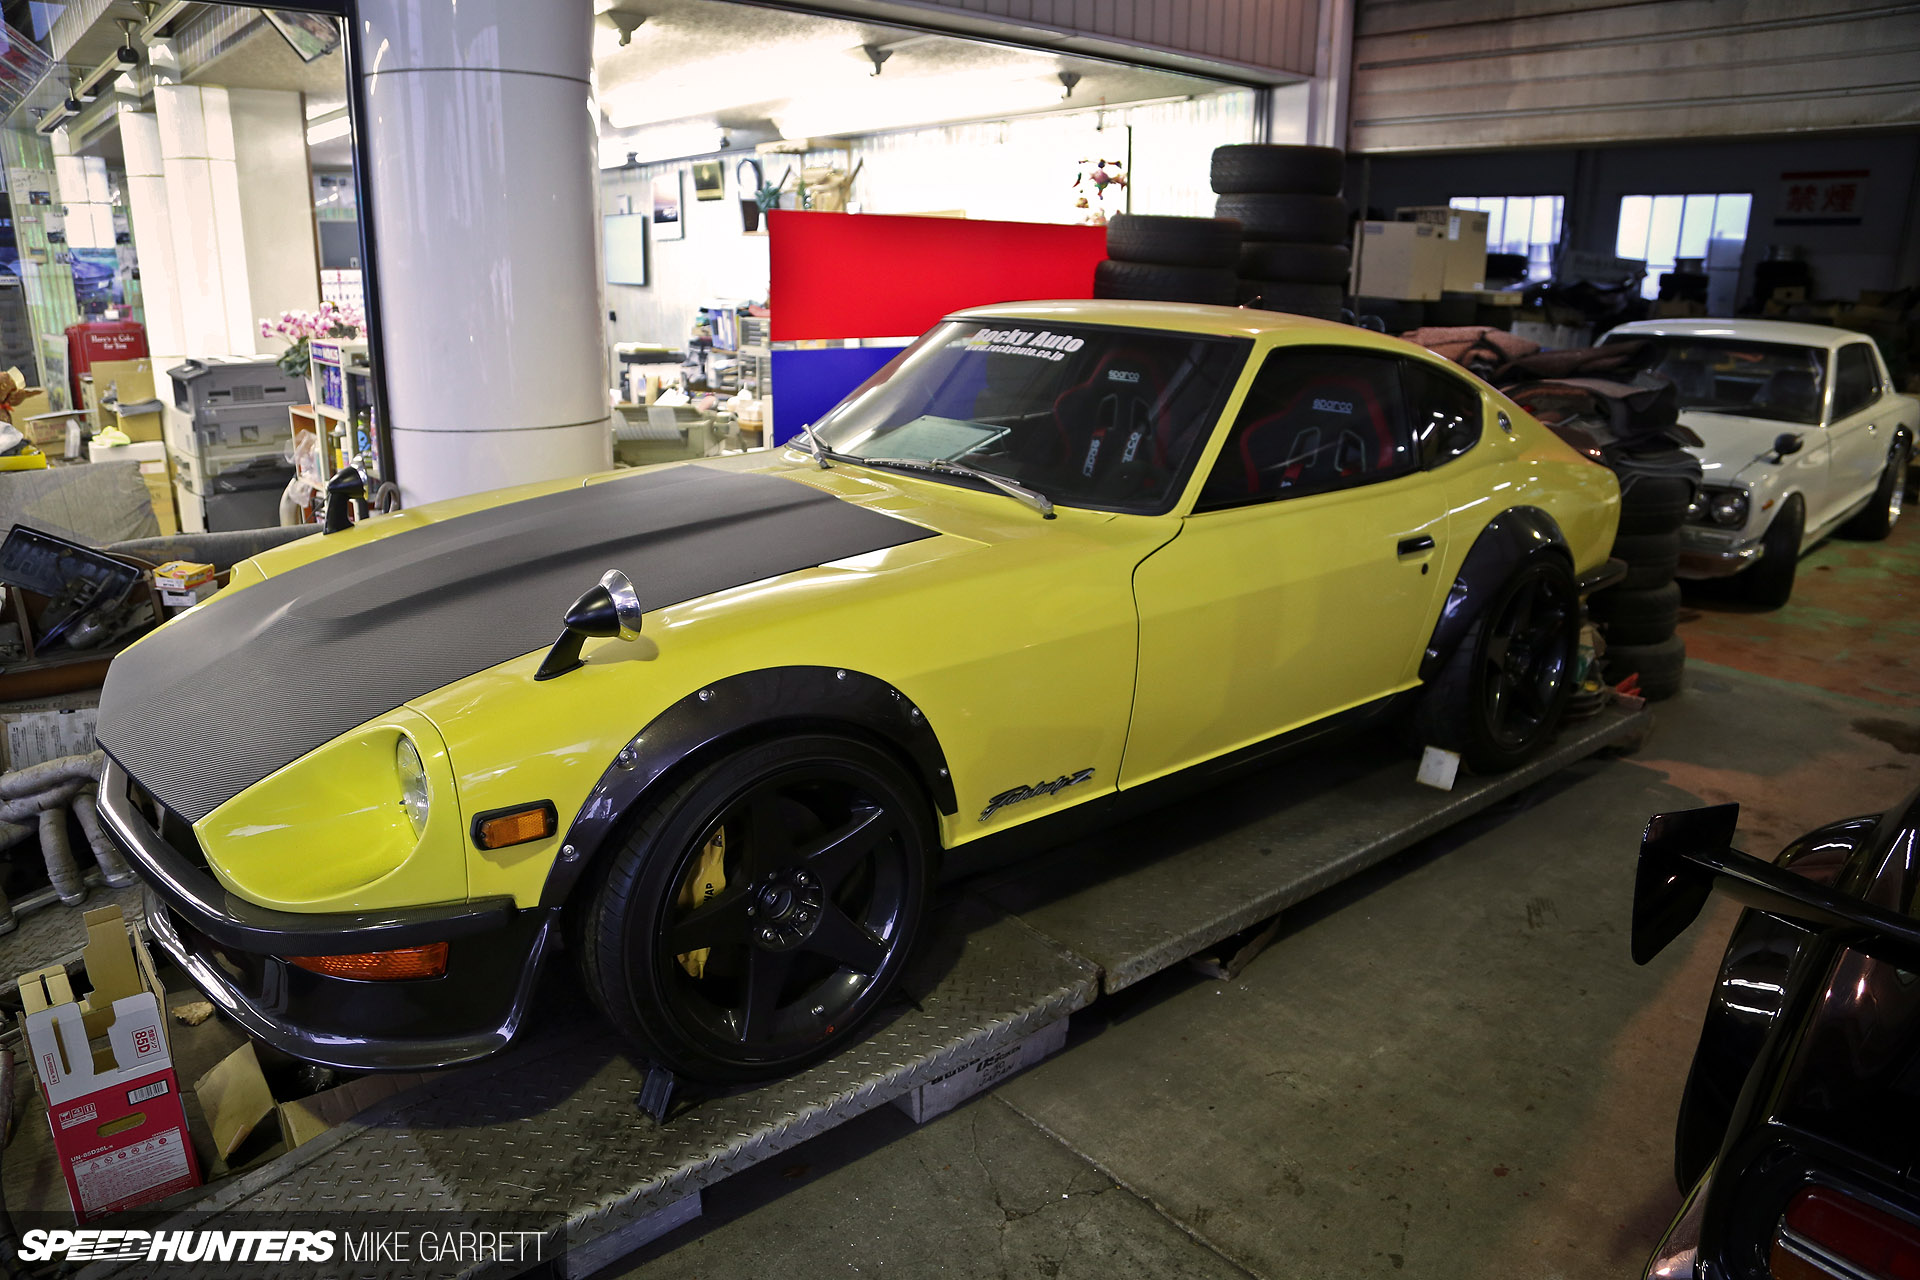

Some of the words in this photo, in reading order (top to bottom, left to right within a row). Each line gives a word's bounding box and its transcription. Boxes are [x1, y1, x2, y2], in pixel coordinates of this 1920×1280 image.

[1785, 183, 1858, 213] 禁煙
[969, 328, 1034, 346] Rocky
[1028, 331, 1085, 352] Auto
[964, 343, 1066, 361] www.rockyauto.co.jp
[1108, 369, 1140, 382] sparco
[1312, 398, 1353, 414] sparco
[134, 1030, 151, 1054] 85D
